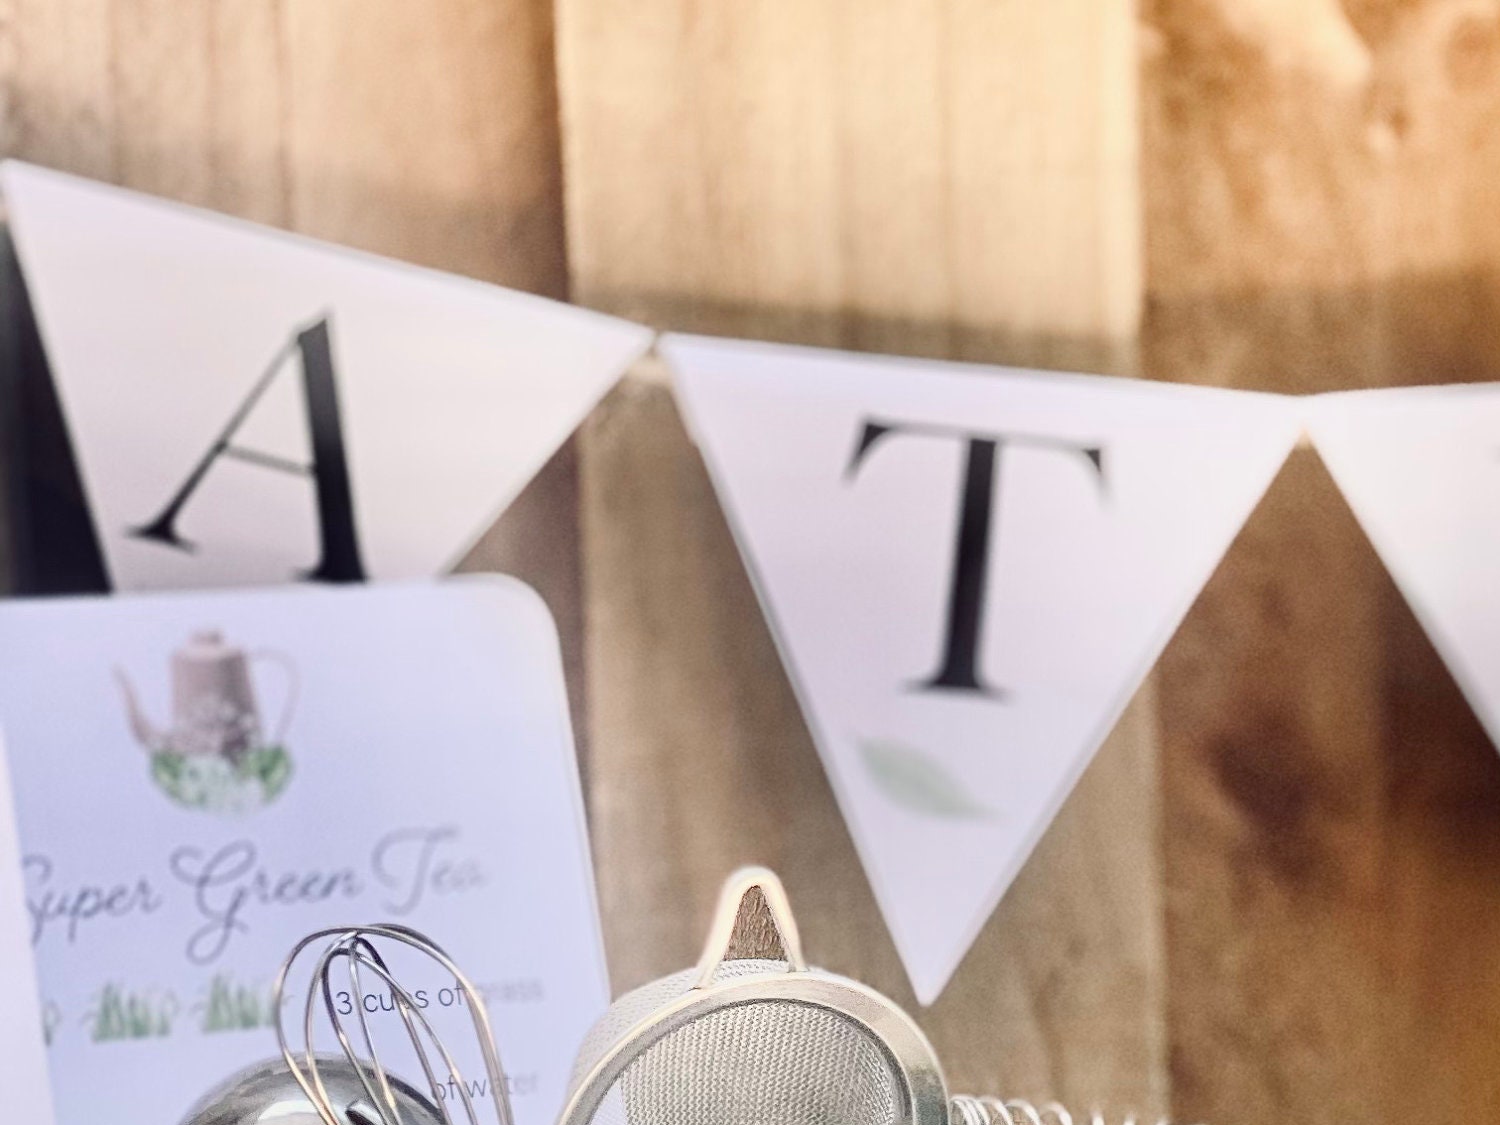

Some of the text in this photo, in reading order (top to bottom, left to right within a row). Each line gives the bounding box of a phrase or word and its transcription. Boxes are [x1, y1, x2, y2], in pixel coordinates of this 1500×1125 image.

[122, 308, 372, 583] A
[845, 416, 1114, 704] T
[169, 839, 363, 966] Green
[371, 825, 487, 916] Tea
[335, 991, 353, 1015] 3
[363, 988, 430, 1014] cus
[438, 979, 465, 1007] of
[464, 1071, 538, 1099] wter
